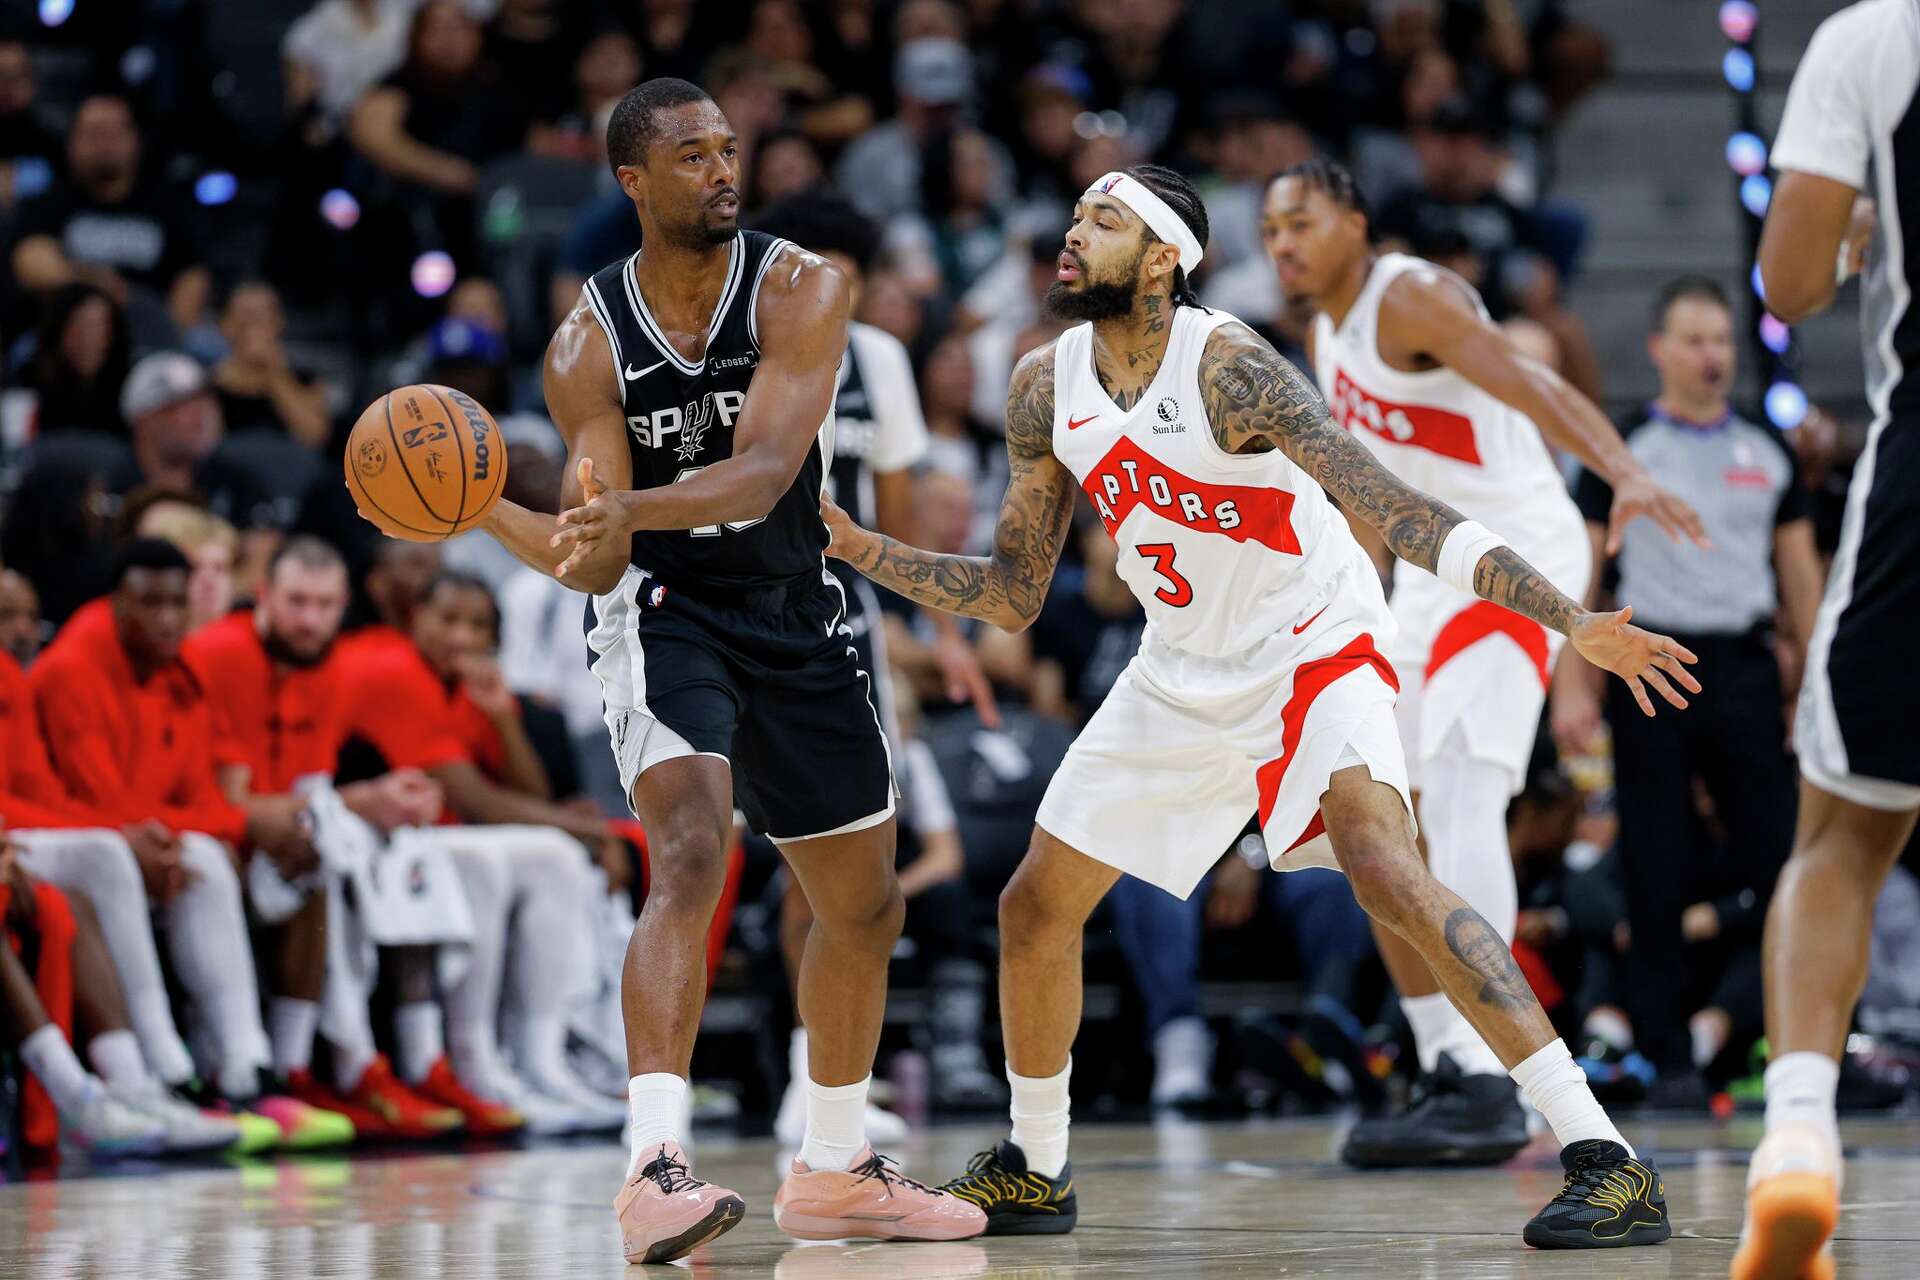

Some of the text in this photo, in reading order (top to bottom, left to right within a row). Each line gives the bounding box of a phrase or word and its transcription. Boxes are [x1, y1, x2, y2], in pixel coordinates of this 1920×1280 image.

[715, 356, 751, 369] LEDGER
[448, 390, 490, 481] Wilson
[627, 390, 747, 461] SPUR
[1152, 422, 1186, 434] Sun Life
[1094, 459, 1241, 532] APTORS
[1135, 542, 1194, 608] 3
